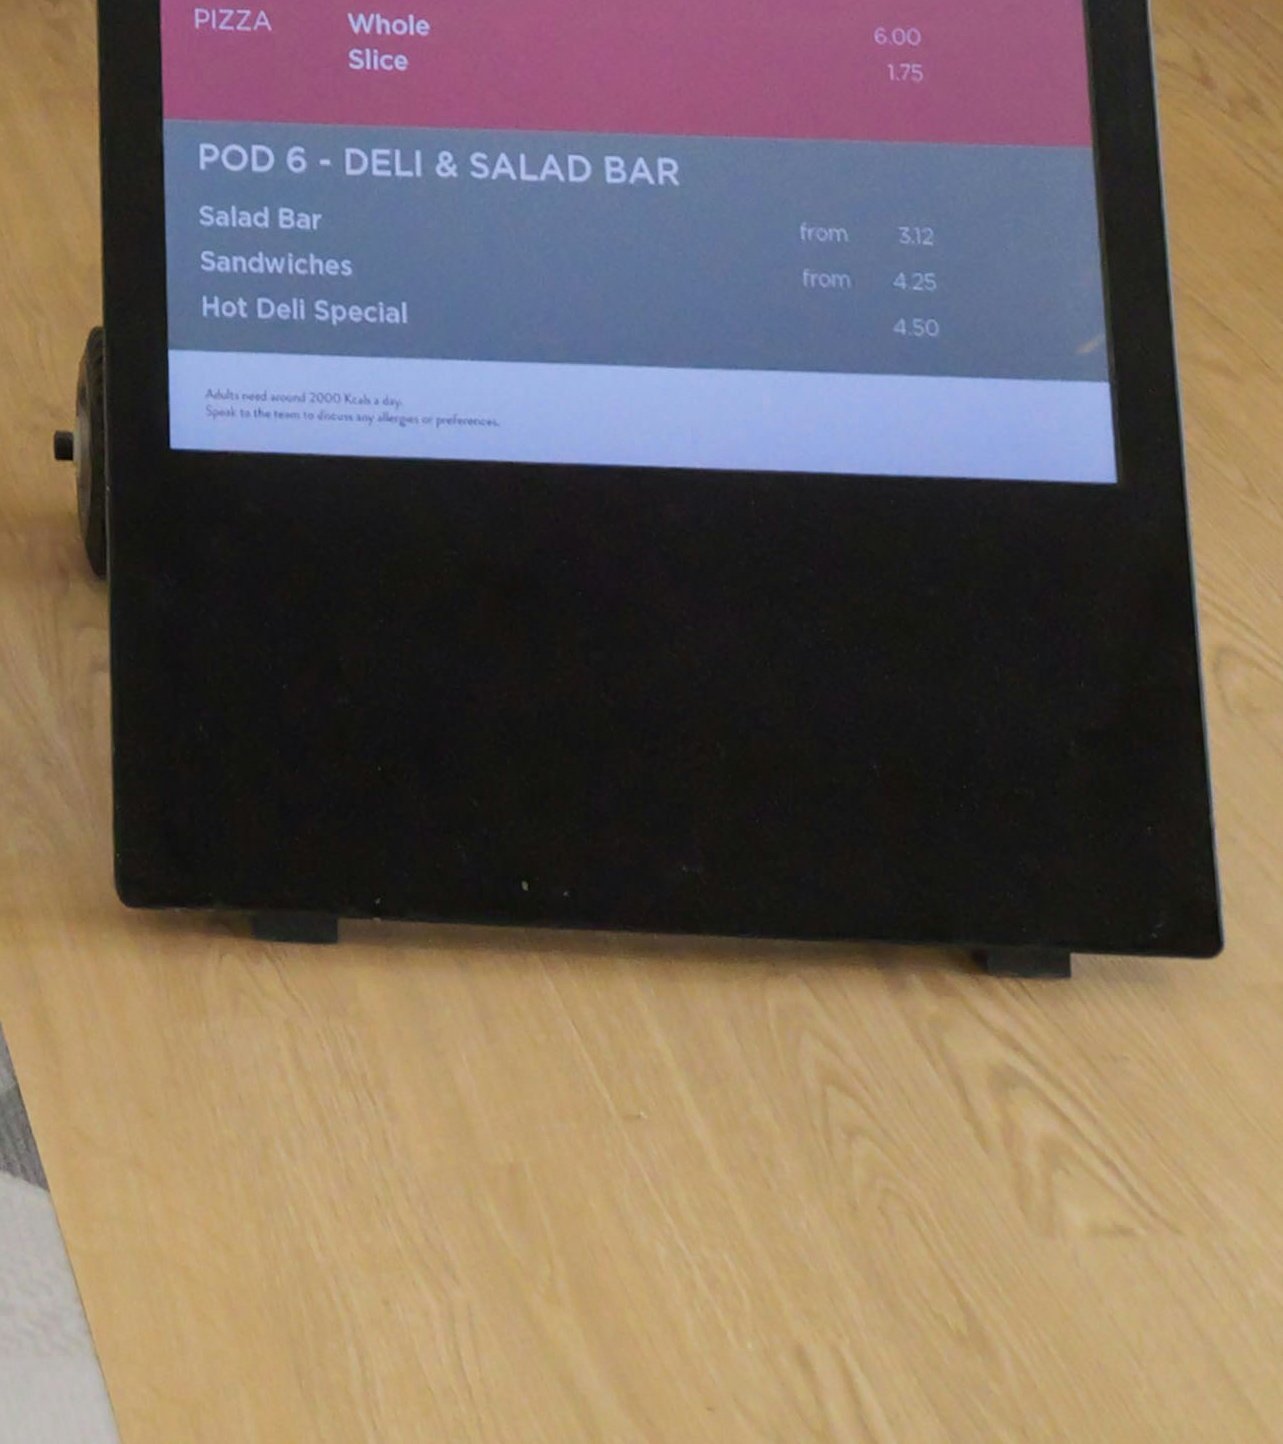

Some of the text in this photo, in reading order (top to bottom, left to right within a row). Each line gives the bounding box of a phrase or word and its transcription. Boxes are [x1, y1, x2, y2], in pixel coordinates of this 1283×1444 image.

[194, 8, 272, 32] PIZZA
[347, 13, 431, 37] Whole
[873, 26, 922, 47] 6.00
[348, 48, 409, 72] Slice
[887, 63, 924, 83] 1.75
[199, 143, 275, 173] POD
[286, 146, 308, 174] 6
[344, 147, 422, 178] DELI
[435, 150, 458, 179] &
[469, 151, 592, 183] SALAD
[604, 155, 680, 186] BAR
[199, 204, 322, 230] Salad Bar
[200, 250, 353, 277] Sandwiches
[202, 295, 408, 326] Hot Deli Special
